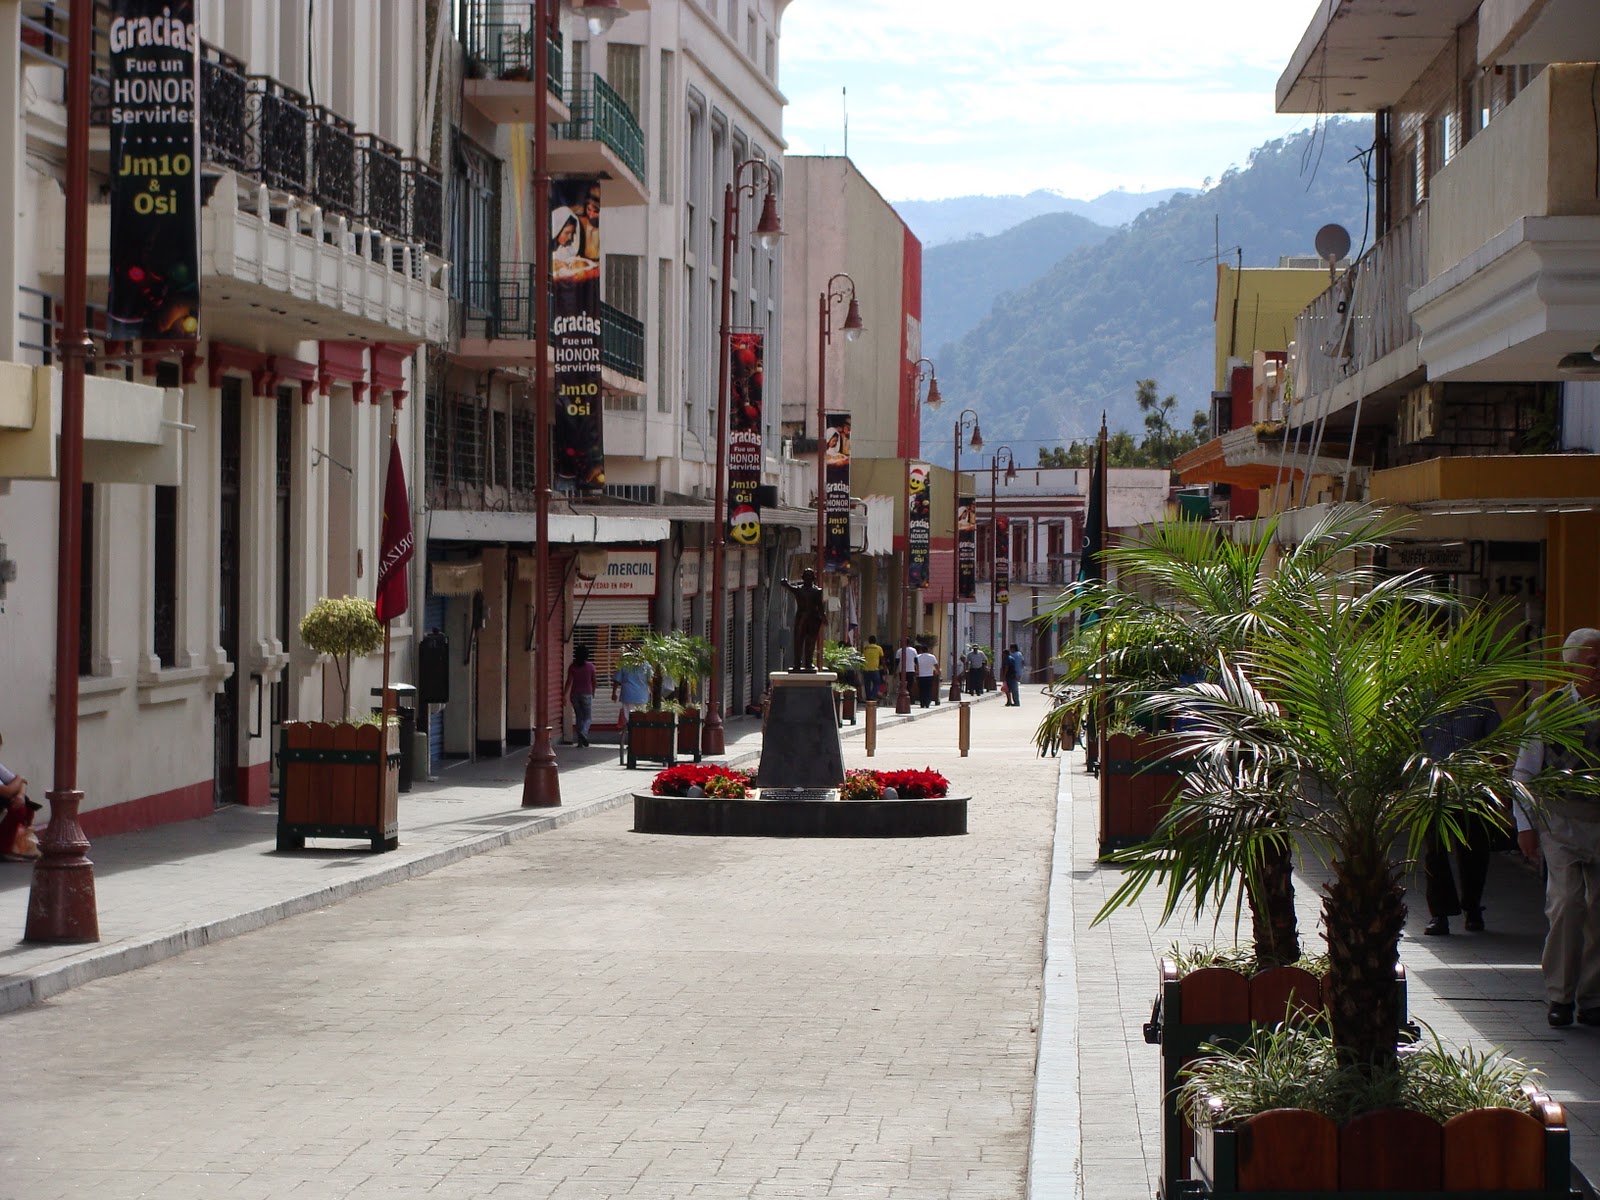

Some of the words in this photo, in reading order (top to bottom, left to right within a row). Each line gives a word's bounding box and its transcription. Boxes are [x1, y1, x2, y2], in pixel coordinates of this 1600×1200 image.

[110, 6, 194, 54] Gracias
[126, 58, 157, 72] Fue
[161, 60, 184, 72] un
[114, 79, 194, 104] HONOR
[111, 105, 194, 124] Servirles
[119, 153, 192, 177] Jm10
[149, 178, 160, 192] &
[134, 189, 177, 215] Osi
[554, 310, 601, 336] Gracias
[562, 337, 580, 346] Fue
[581, 337, 593, 346] un
[556, 348, 600, 362] HONOR
[555, 362, 601, 373] Servirles
[559, 383, 598, 396] Jm10
[567, 402, 590, 416] Osi
[730, 428, 762, 446] Gracias
[730, 453, 760, 464] HONOR
[729, 463, 760, 471] Servirles
[731, 480, 758, 489] Jm10
[827, 480, 849, 494] Gracias
[735, 494, 753, 503] Osi
[827, 499, 849, 507] HONOR
[831, 527, 845, 535] Osi
[603, 562, 655, 576] MERCIAL
[1496, 575, 1537, 595] 151
